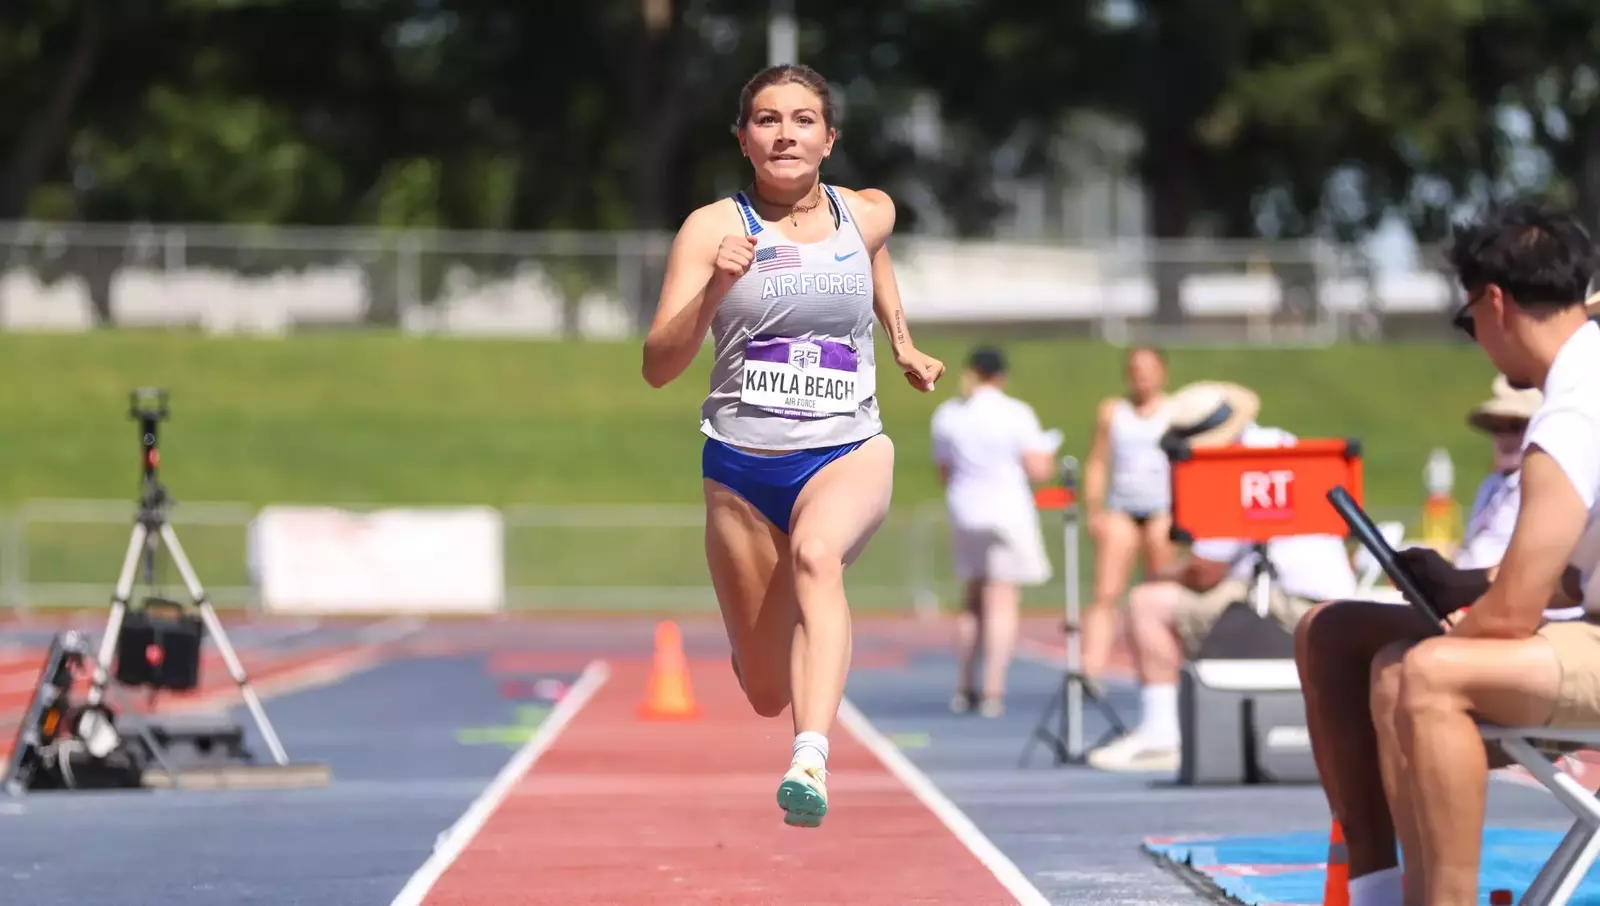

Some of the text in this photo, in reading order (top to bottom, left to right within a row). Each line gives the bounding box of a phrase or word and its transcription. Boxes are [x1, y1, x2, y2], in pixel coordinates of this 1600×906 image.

[761, 273, 867, 300] AIR FORCE
[746, 370, 855, 400] KAYLA BEACH
[785, 397, 816, 408] AIR FORCE
[1240, 470, 1295, 508] RT
